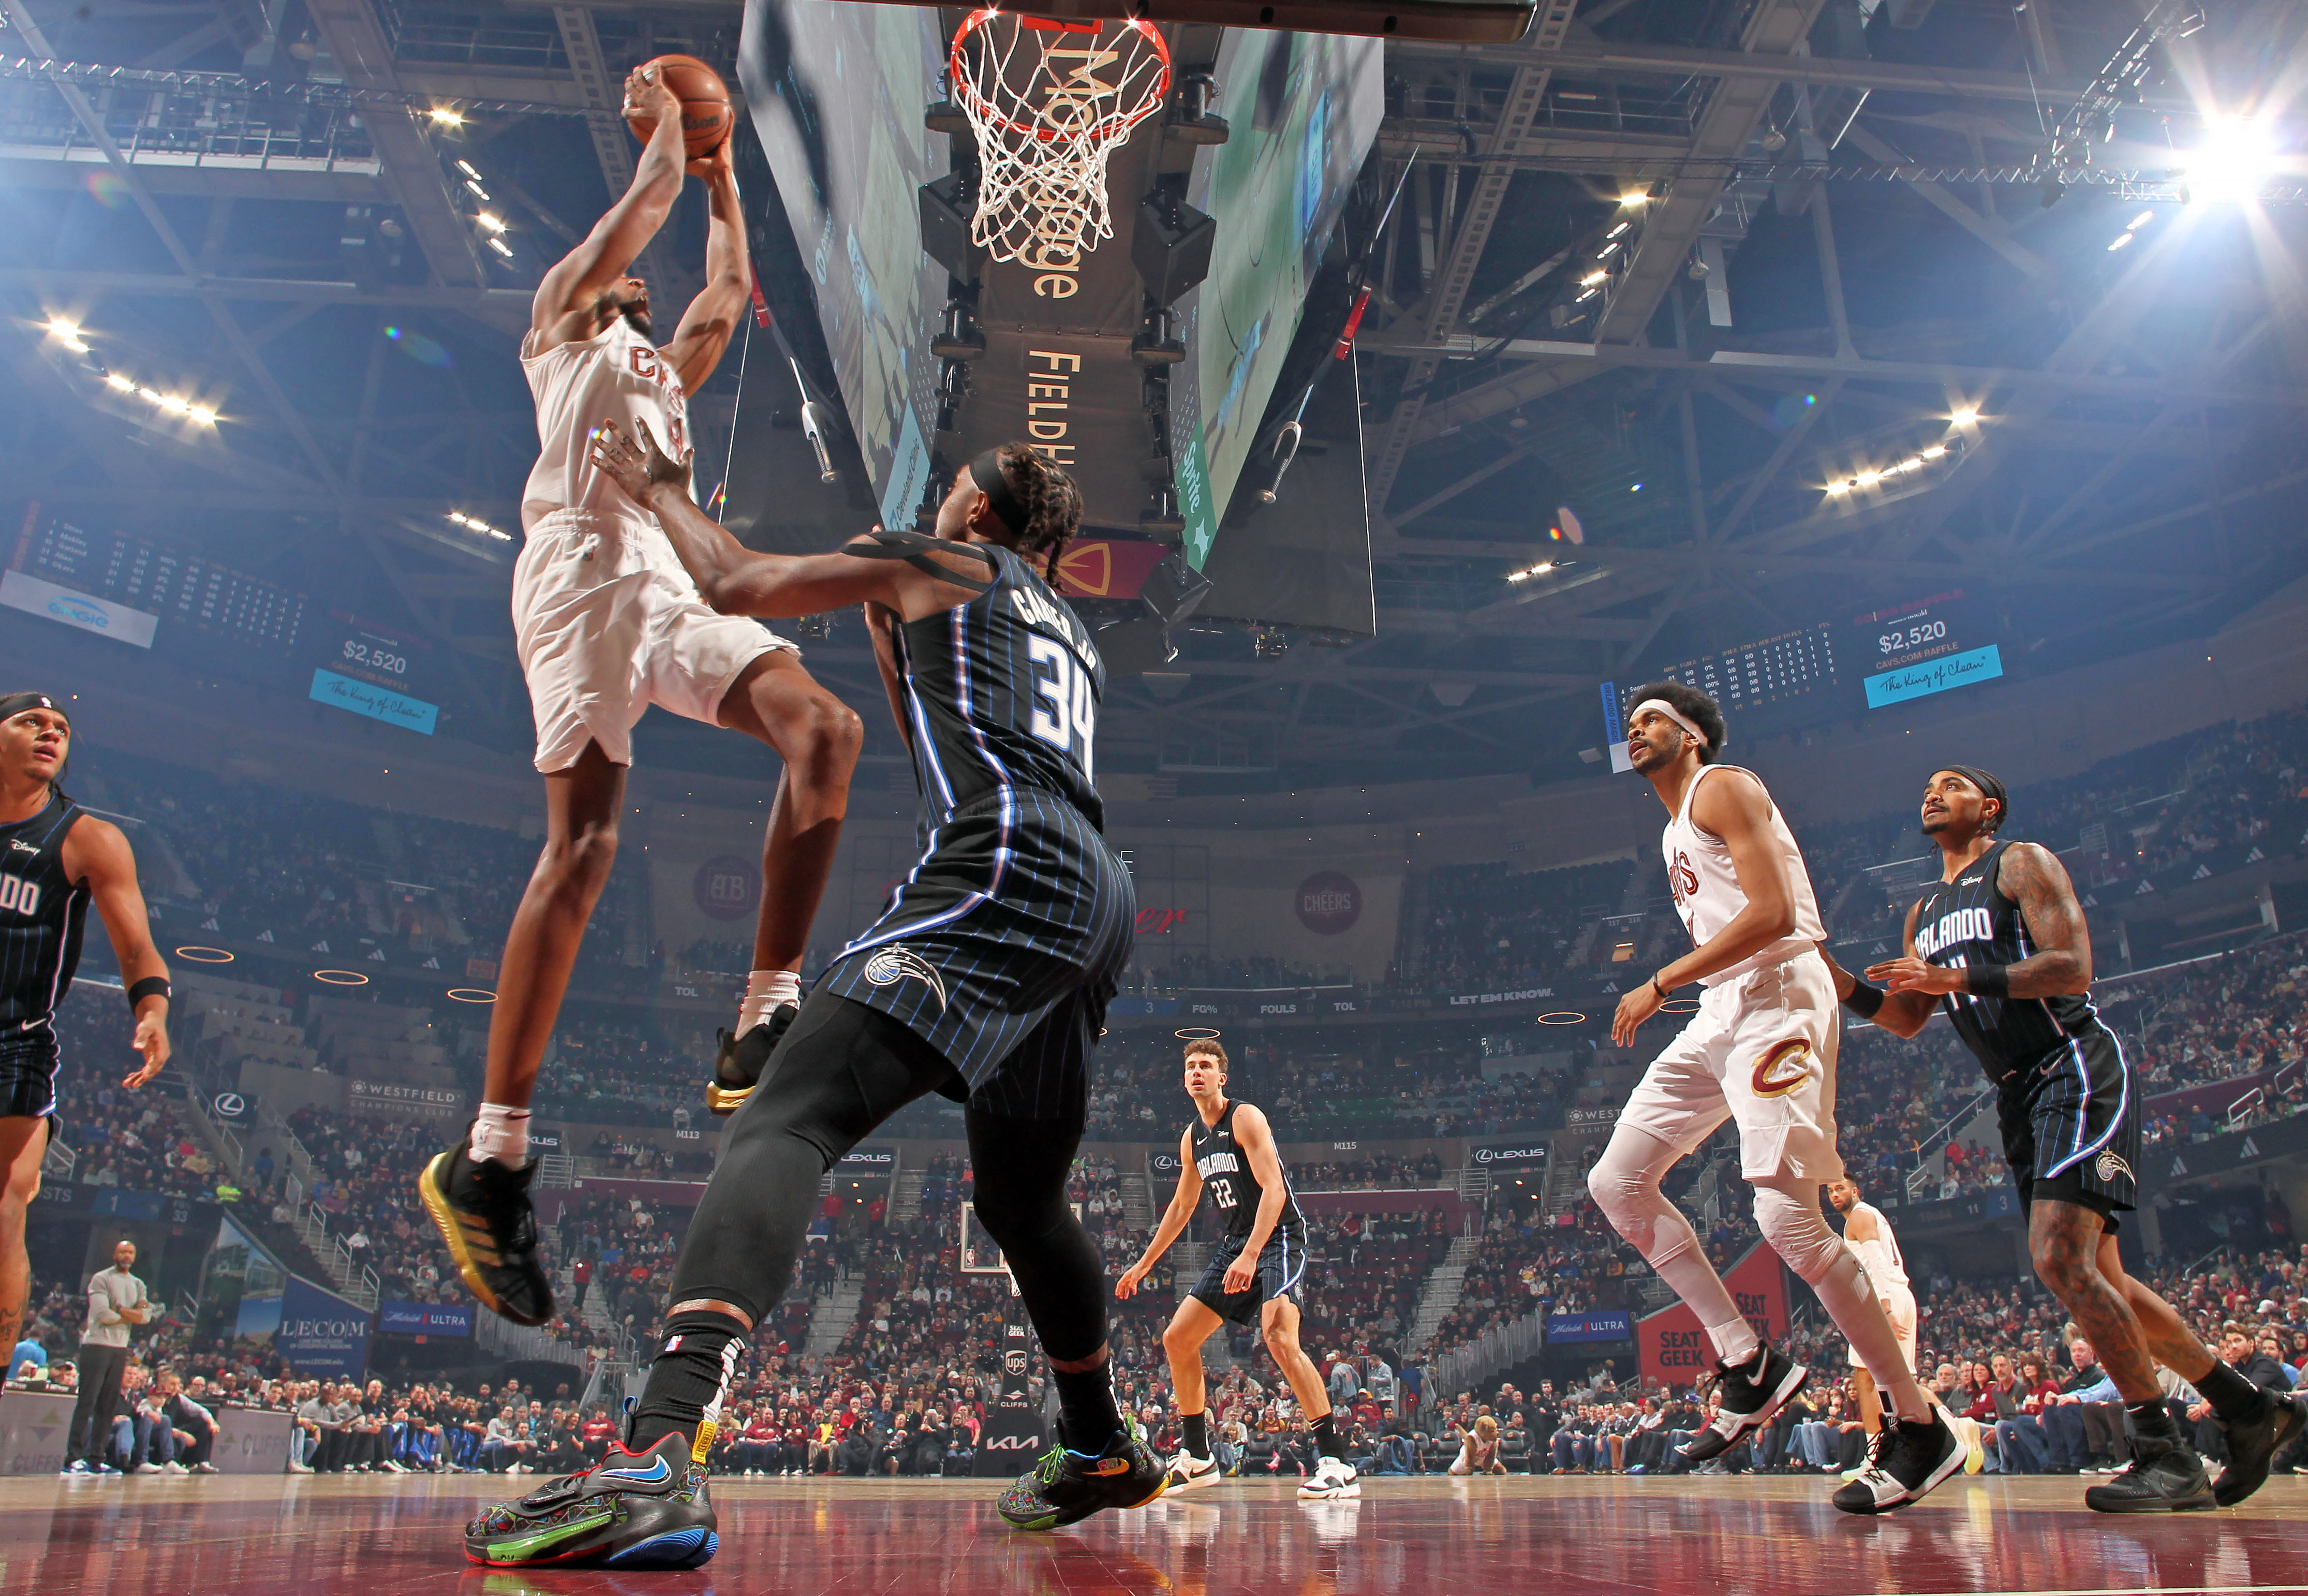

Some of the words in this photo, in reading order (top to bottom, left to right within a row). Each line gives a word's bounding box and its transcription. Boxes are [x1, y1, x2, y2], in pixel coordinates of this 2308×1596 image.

[896, 464, 914, 521] Cleveland
[909, 438, 920, 472] Clinic
[1183, 441, 1201, 514] Sprite
[1878, 621, 1946, 654] $2,520
[343, 640, 406, 674] $2,520
[1880, 676, 1902, 692] The
[1904, 673, 1931, 688] King
[1934, 666, 1946, 686] of
[328, 682, 348, 697] The
[350, 687, 375, 711] King
[377, 697, 389, 715] of
[1028, 632, 1094, 781] 34
[1604, 685, 1614, 717] ORLANDO
[1609, 719, 1619, 742] MAGIC
[11, 839, 41, 855] Disney
[1960, 876, 1983, 886] Disney
[1304, 893, 1351, 912] CHEERS
[1914, 907, 1993, 962] ORLANDO
[675, 986, 698, 997] TOL
[1451, 995, 1479, 1005] LET
[1481, 993, 1502, 1003] EM
[1503, 988, 1555, 1001] KNOW.
[1145, 1001, 1154, 1013] 3
[1192, 1004, 1218, 1014] FG%
[1261, 1004, 1297, 1014] FOULS
[1334, 1002, 1356, 1012] TOL
[369, 1085, 455, 1103] WESTFIELD
[350, 1099, 419, 1114] CHAMPIONS
[425, 1107, 454, 1117] CLUB
[676, 1130, 700, 1139] M113
[1334, 1142, 1357, 1150] M115
[1495, 1149, 1545, 1159] LEXUS
[1196, 1152, 1239, 1181] ORLANDO
[110, 1194, 119, 1212] 1
[1210, 1179, 1238, 1209] 22
[1966, 1204, 1979, 1215] 11
[1735, 1292, 1766, 1315] SEAT
[431, 1314, 466, 1326] ULTRA
[1590, 1321, 1624, 1331] ULTRA
[1661, 1331, 1701, 1349] SEAT
[1007, 1358, 1025, 1372] ups
[1661, 1350, 1706, 1367] GEEK
[14, 1453, 61, 1471] CLIFFS
